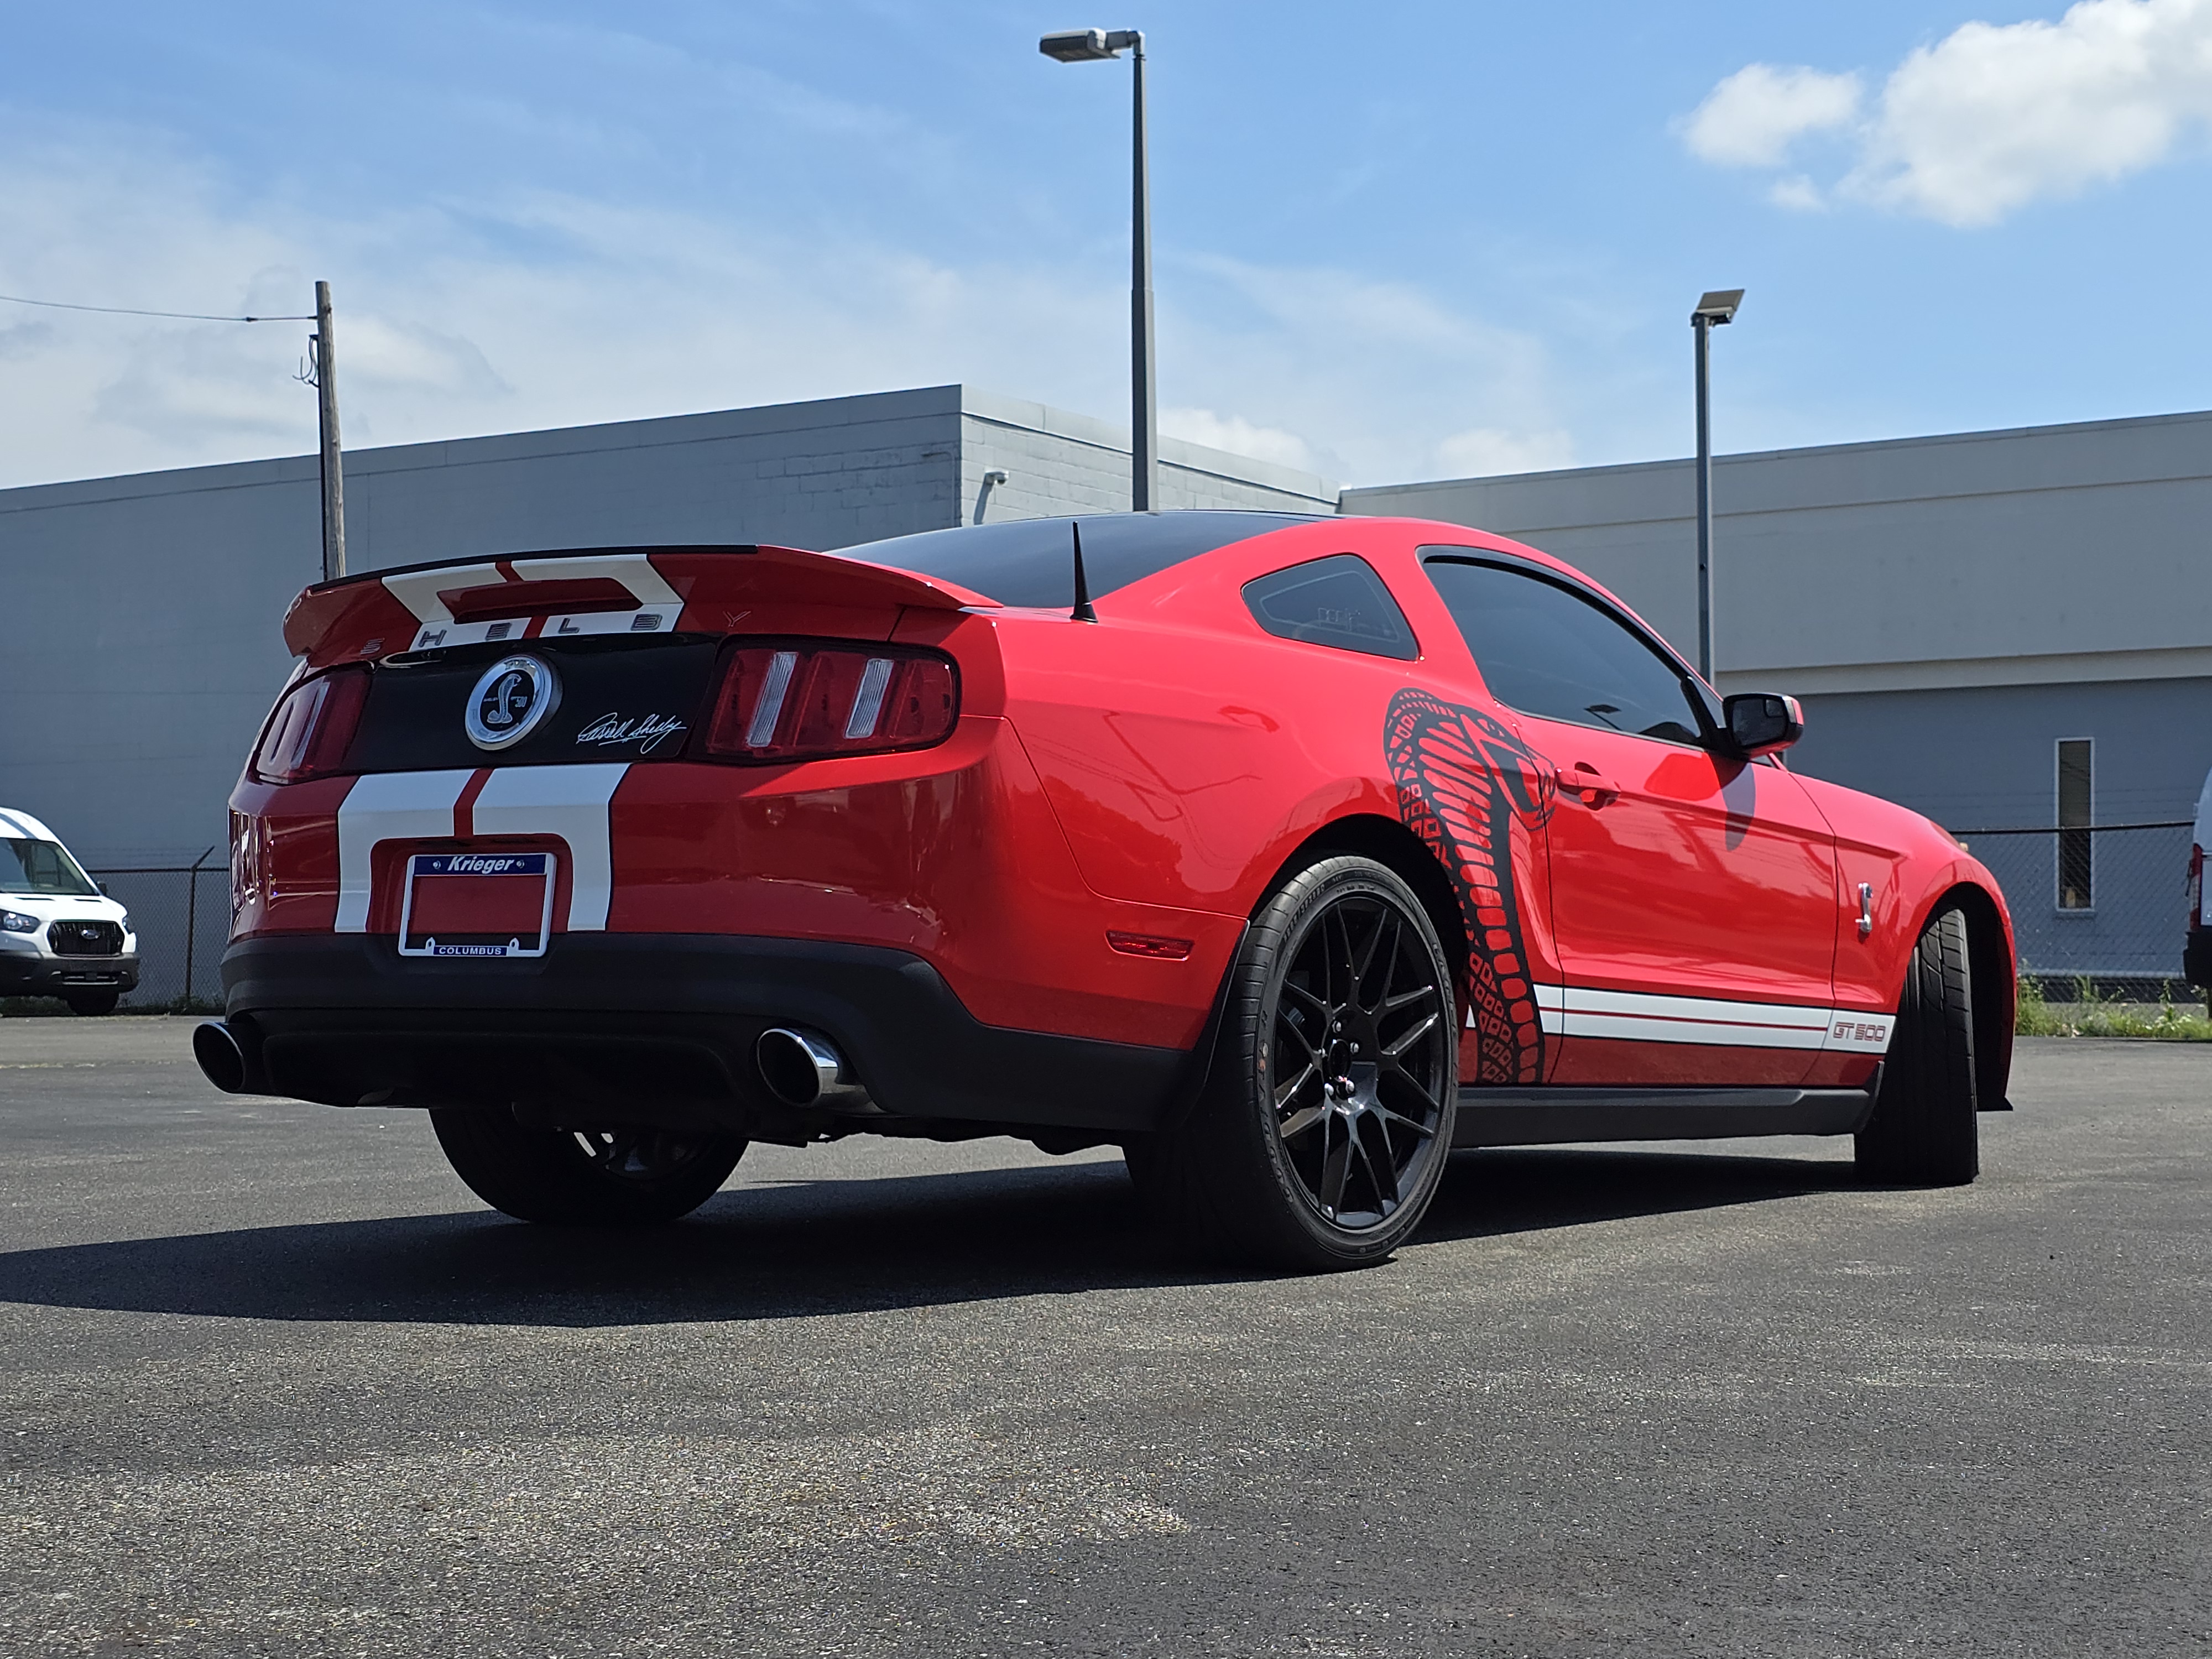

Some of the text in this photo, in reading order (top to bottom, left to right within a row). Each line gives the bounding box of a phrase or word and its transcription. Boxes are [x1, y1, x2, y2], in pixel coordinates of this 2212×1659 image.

[360, 611, 751, 655] SHELBY
[447, 856, 514, 874] Krieger
[439, 947, 502, 956] COLUMBUS
